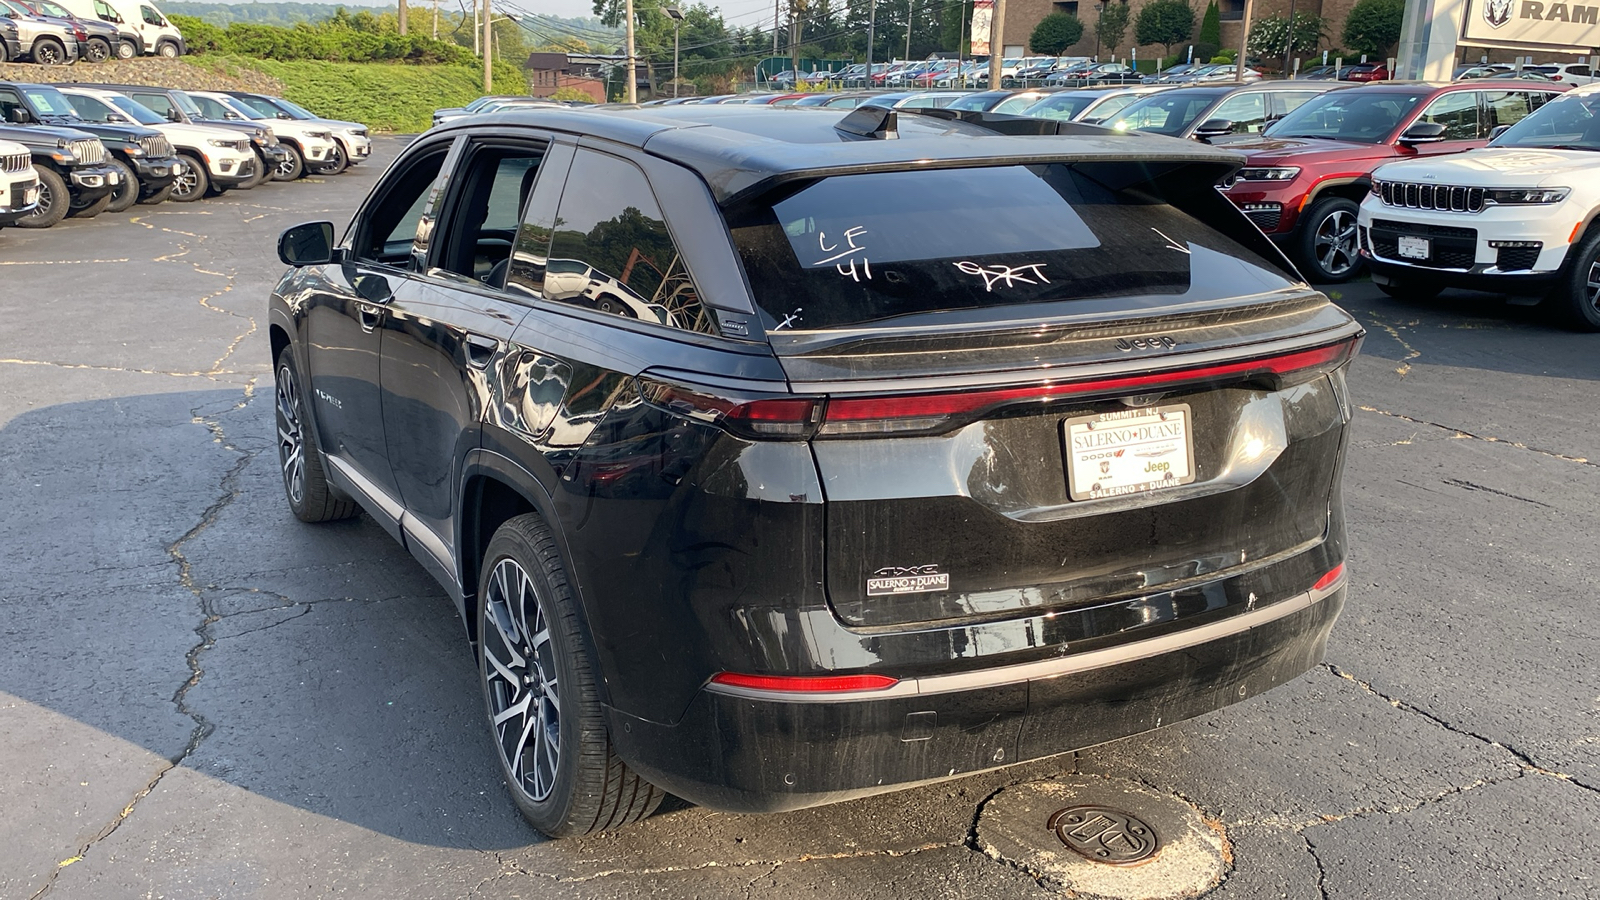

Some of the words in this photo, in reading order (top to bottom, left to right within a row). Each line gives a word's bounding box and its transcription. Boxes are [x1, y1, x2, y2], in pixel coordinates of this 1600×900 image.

[1520, 1, 1599, 25] RAM
[1115, 335, 1177, 352] Jeep
[1074, 429, 1132, 449] SALERNO
[1139, 422, 1182, 441] DUANE
[1144, 461, 1170, 473] Jeep
[1089, 484, 1136, 499] SALERNO
[1150, 477, 1181, 490] DUANE
[870, 579, 909, 589] SALERNO
[917, 575, 947, 586] DUANE
